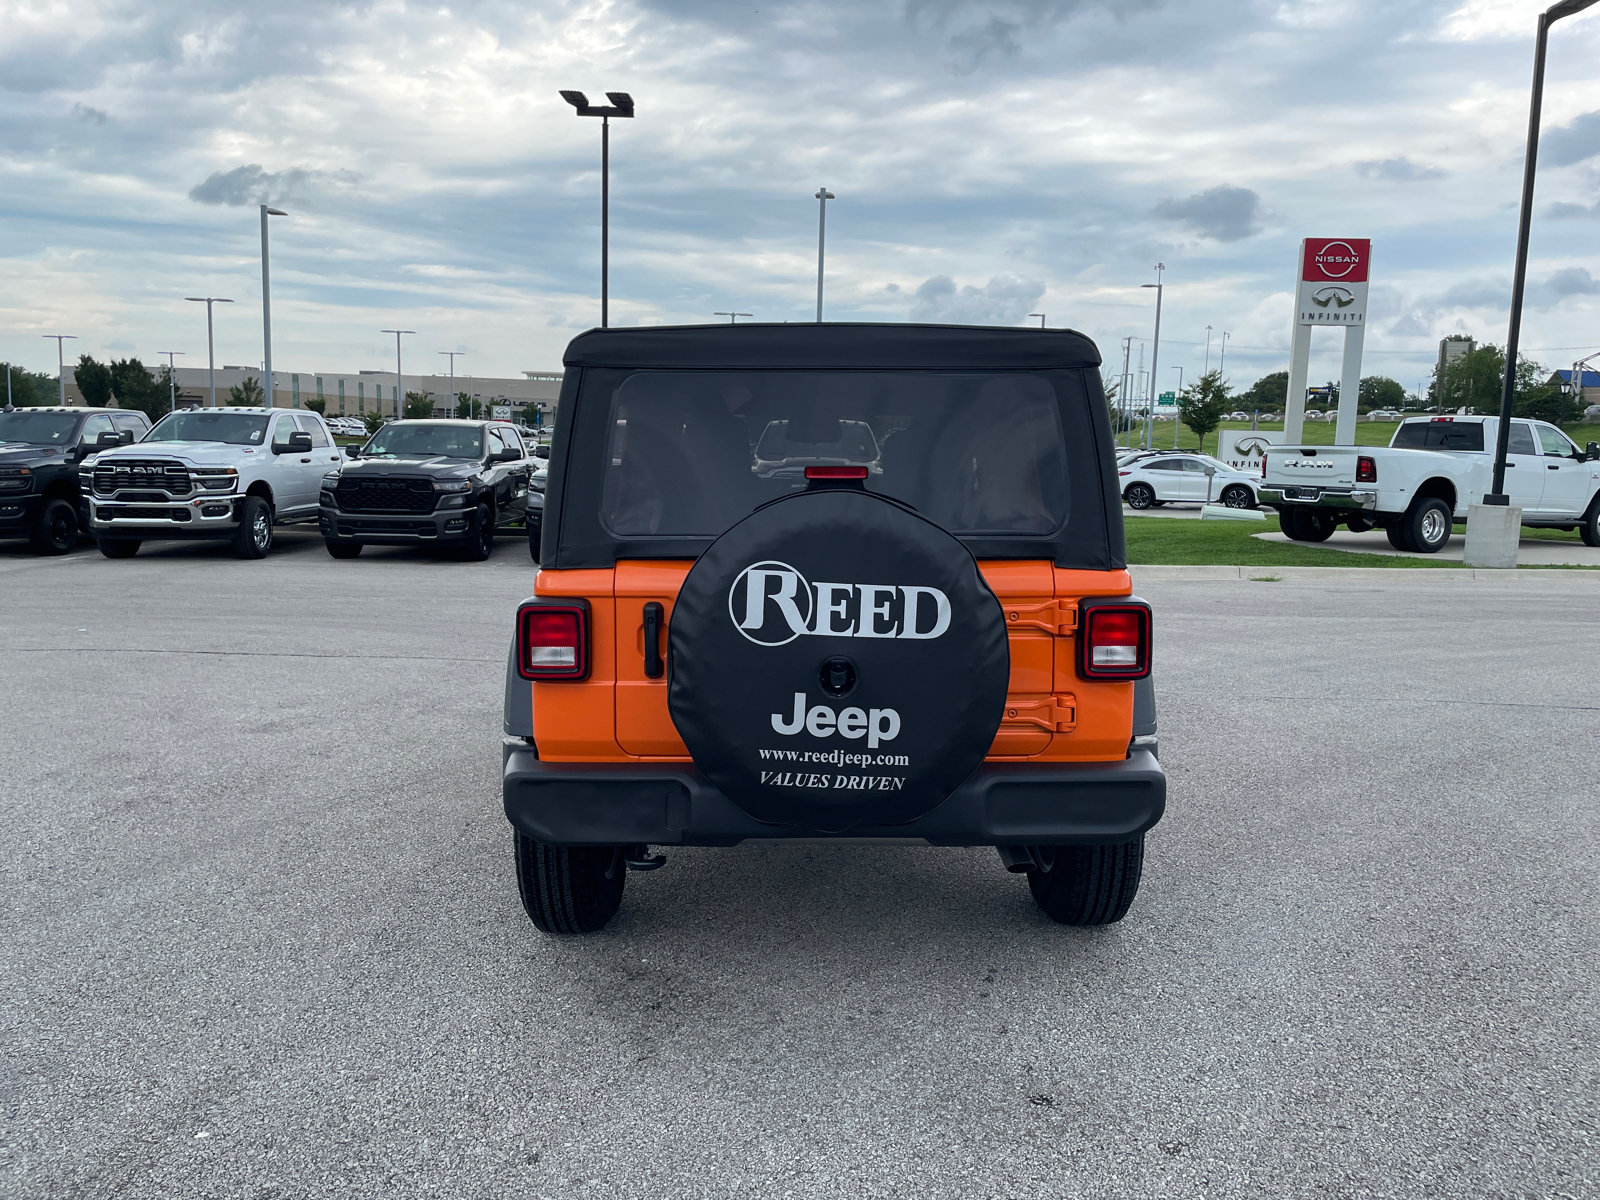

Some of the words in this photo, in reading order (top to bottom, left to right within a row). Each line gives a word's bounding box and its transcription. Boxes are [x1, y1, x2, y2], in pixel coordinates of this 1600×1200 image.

[1315, 255, 1359, 263] NISSAN
[1301, 312, 1362, 321] INFINITI
[1226, 460, 1260, 468] INFIN
[1284, 459, 1334, 469] RAM
[116, 466, 163, 474] RAM
[738, 568, 952, 640] REED
[770, 692, 901, 749] Jeep
[758, 749, 910, 769] www.reedjeep.com
[759, 771, 831, 789] VALUES
[832, 774, 907, 791] DRIVEN
